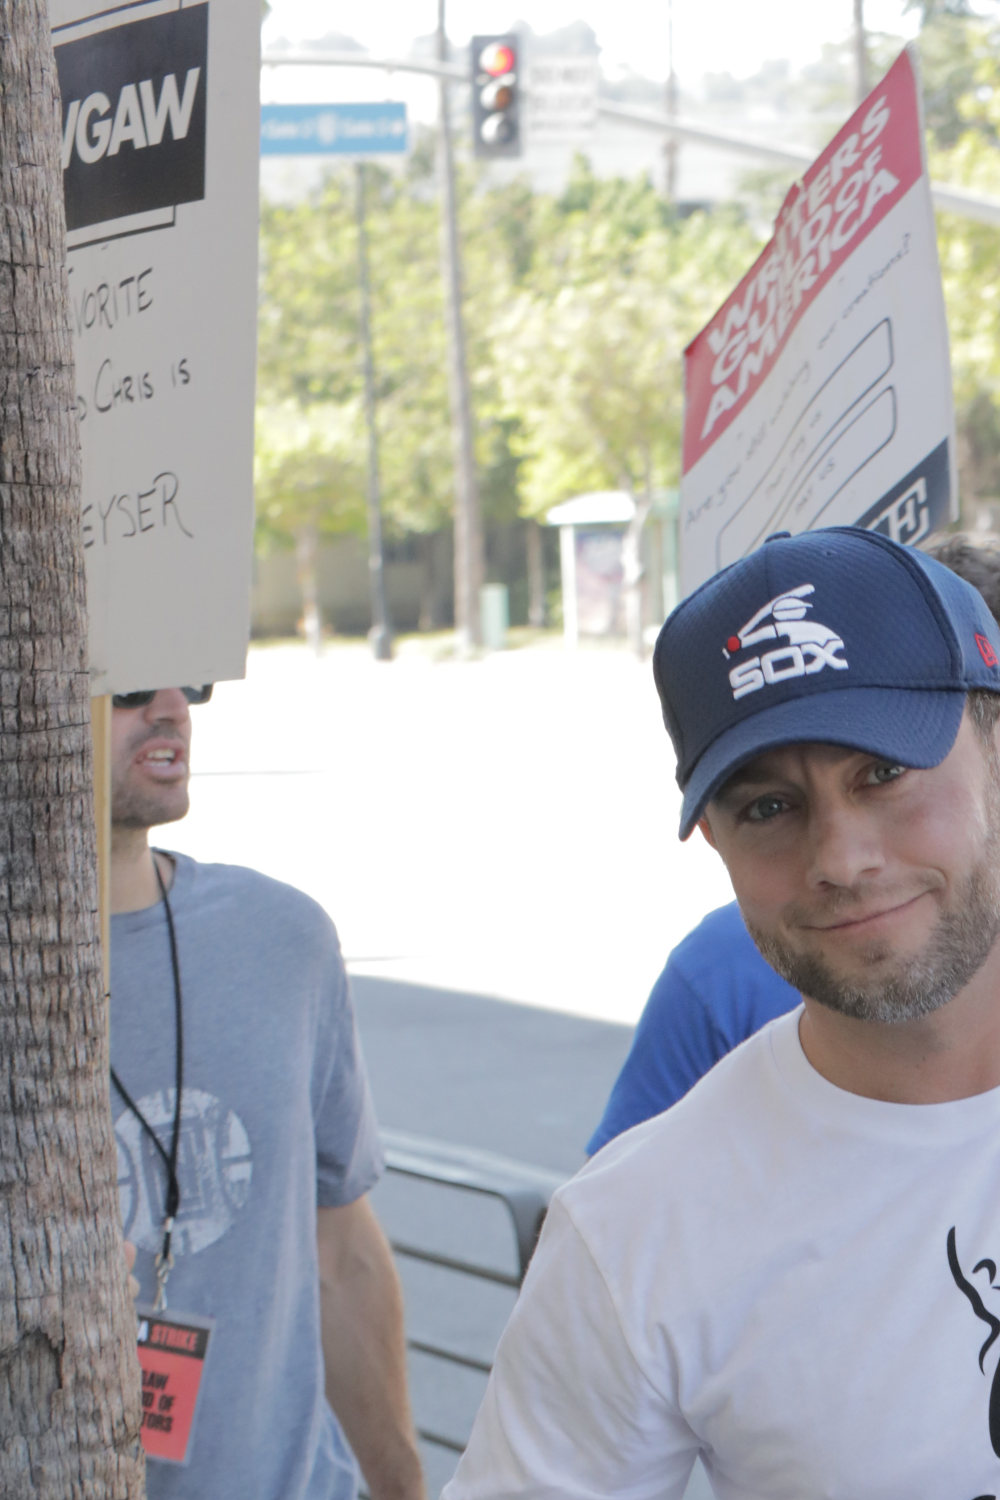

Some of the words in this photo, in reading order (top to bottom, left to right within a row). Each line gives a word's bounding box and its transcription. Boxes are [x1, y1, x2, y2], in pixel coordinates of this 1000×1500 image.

[707, 94, 891, 355] WRITERS
[74, 267, 154, 338] VORITE
[700, 168, 900, 442] AMERICA
[710, 202, 832, 386] GUILD
[835, 145, 882, 206] OF
[82, 470, 195, 549] EYSER
[728, 636, 850, 701] SOX
[151, 1323, 199, 1352] STRIKE
